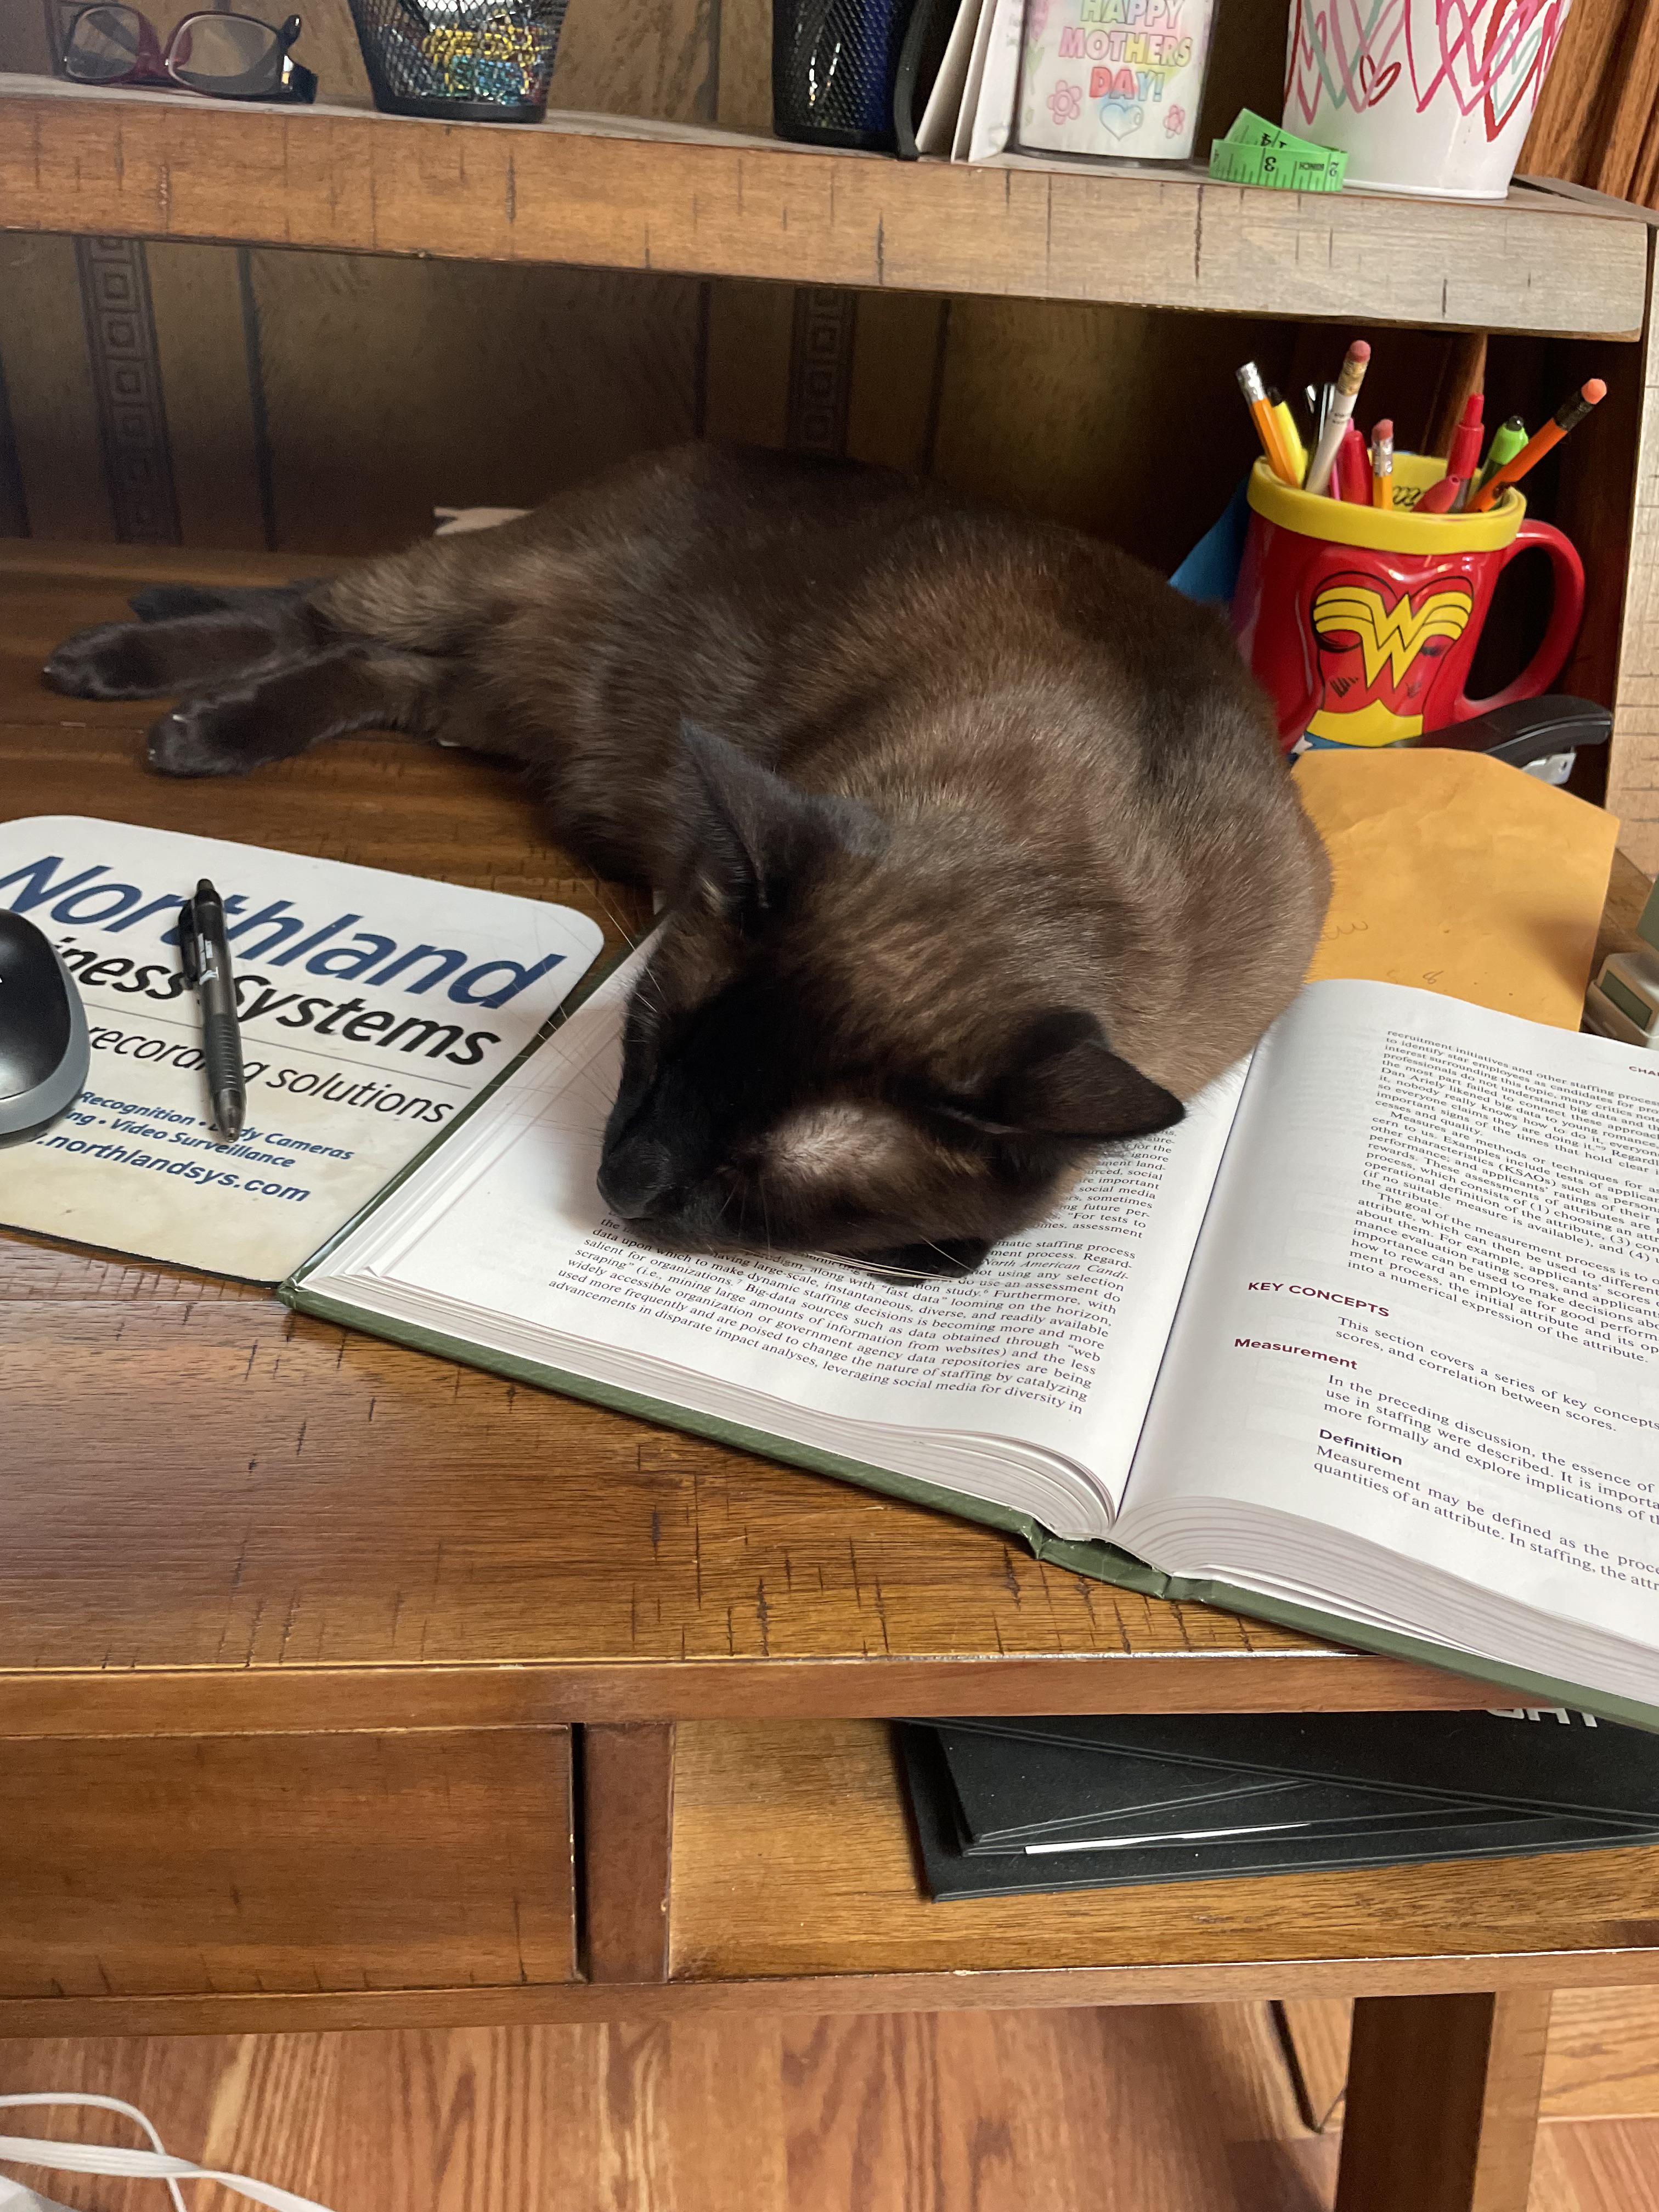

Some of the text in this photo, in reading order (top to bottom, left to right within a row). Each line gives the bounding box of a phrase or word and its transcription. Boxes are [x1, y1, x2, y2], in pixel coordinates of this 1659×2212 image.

[1081, 0, 1184, 29] HAPPY
[1058, 26, 1193, 67] MOTHERS
[1089, 66, 1165, 102] DAY!
[1264, 156, 1276, 172] 3
[266, 1068, 454, 1124] solutions
[1629, 1066, 1659, 1077] CHA
[80, 1091, 196, 1126] Recognition
[264, 1132, 356, 1160] Cameras
[111, 1118, 167, 1139] Video
[168, 1132, 296, 1167] Surveillance
[1374, 1100, 1482, 1137] cesses and quality.
[1390, 1110, 1446, 1133] Measures
[1451, 1130, 1470, 1141] are
[1475, 1138, 1527, 1159] methods
[1532, 1156, 1546, 1165] or
[1551, 1161, 1618, 1184] techniques
[1624, 1180, 1643, 1190] for
[1100, 1214, 1128, 1224] tests
[1133, 1219, 1147, 1228] to
[1118, 1187, 1156, 1199] media
[1020, 1260, 1080, 1271] American
[1087, 1264, 1129, 1280] Candi-
[1035, 1240, 1136, 1260] staffing process
[574, 1249, 1096, 1375] scraping” (i.e., mining large amounts of information from websites) and the less
[592, 1228, 618, 1242] data
[621, 1237, 653, 1252] upon
[656, 1248, 692, 1263] which
[695, 1258, 708, 1267] to
[710, 1263, 744, 1277] make
[746, 1272, 800, 1293] dynamic
[803, 1289, 851, 1310] staffing
[854, 1304, 913, 1324] decisions
[917, 1318, 928, 1327] is
[932, 1318, 996, 1333] becoming
[999, 1325, 1035, 1334] more
[1038, 1328, 1065, 1339] and
[1068, 1333, 1104, 1350] more
[1248, 1282, 1389, 1317] KEY CONCEPTS
[1347, 1259, 1374, 1274] into
[1390, 1273, 1457, 1303] numerical
[1461, 1299, 1532, 1329] expression
[1537, 1325, 1553, 1335] of
[1556, 1330, 1578, 1343] the
[1582, 1339, 1647, 1363] attribute.
[1351, 1238, 1379, 1252] how
[1383, 1248, 1396, 1258] to
[1400, 1254, 1444, 1275] reward
[1449, 1271, 1465, 1282] an
[1469, 1279, 1532, 1306] employee
[1537, 1300, 1556, 1313] for
[1560, 1309, 1595, 1325] good
[548, 1280, 1082, 1415] advancements in disparate impact analyses, leveraging social media for diversity in
[557, 1269, 1087, 1403] used more frequently and are poised to change the nature of staffing by catalyzing
[1234, 1338, 1357, 1371] Measurement
[1338, 1316, 1368, 1333] This
[1374, 1329, 1424, 1353] section
[1430, 1349, 1474, 1372] covers
[1480, 1368, 1488, 1377] a
[1494, 1373, 1534, 1393] series
[1541, 1389, 1558, 1400] of
[1562, 1393, 1587, 1410] key
[1335, 1330, 1616, 1432] scores, and correlation between scores.
[1319, 1428, 1402, 1466] Definition
[1323, 1403, 1362, 1421] more
[1367, 1414, 1429, 1446] formally
[1432, 1441, 1460, 1459] and
[1465, 1454, 1521, 1481] explore
[1526, 1476, 1622, 1515] implications
[1627, 1509, 1643, 1521] of
[1326, 1389, 1350, 1403] use
[1356, 1398, 1369, 1410] in
[1375, 1406, 1431, 1434] staffing
[1437, 1427, 1471, 1448] were
[1476, 1443, 1554, 1478] described.
[1561, 1470, 1572, 1485] It
[1579, 1476, 1591, 1490] is
[1328, 1374, 1653, 1494] In the preceding discussion, the essence of
[1313, 1462, 1389, 1494] quantities
[1392, 1490, 1407, 1502] of
[1411, 1497, 1429, 1511] an
[1434, 1506, 1504, 1541] attribute.
[1510, 1532, 1525, 1548] In
[1530, 1543, 1595, 1573] staffing,
[1600, 1565, 1626, 1581] the
[1316, 1444, 1420, 1492] Measurement
[1427, 1488, 1459, 1507] may
[1467, 1500, 1485, 1516] be
[1492, 1511, 1551, 1541] defined
[1559, 1537, 1576, 1549] as
[1583, 1543, 1609, 1560] the
